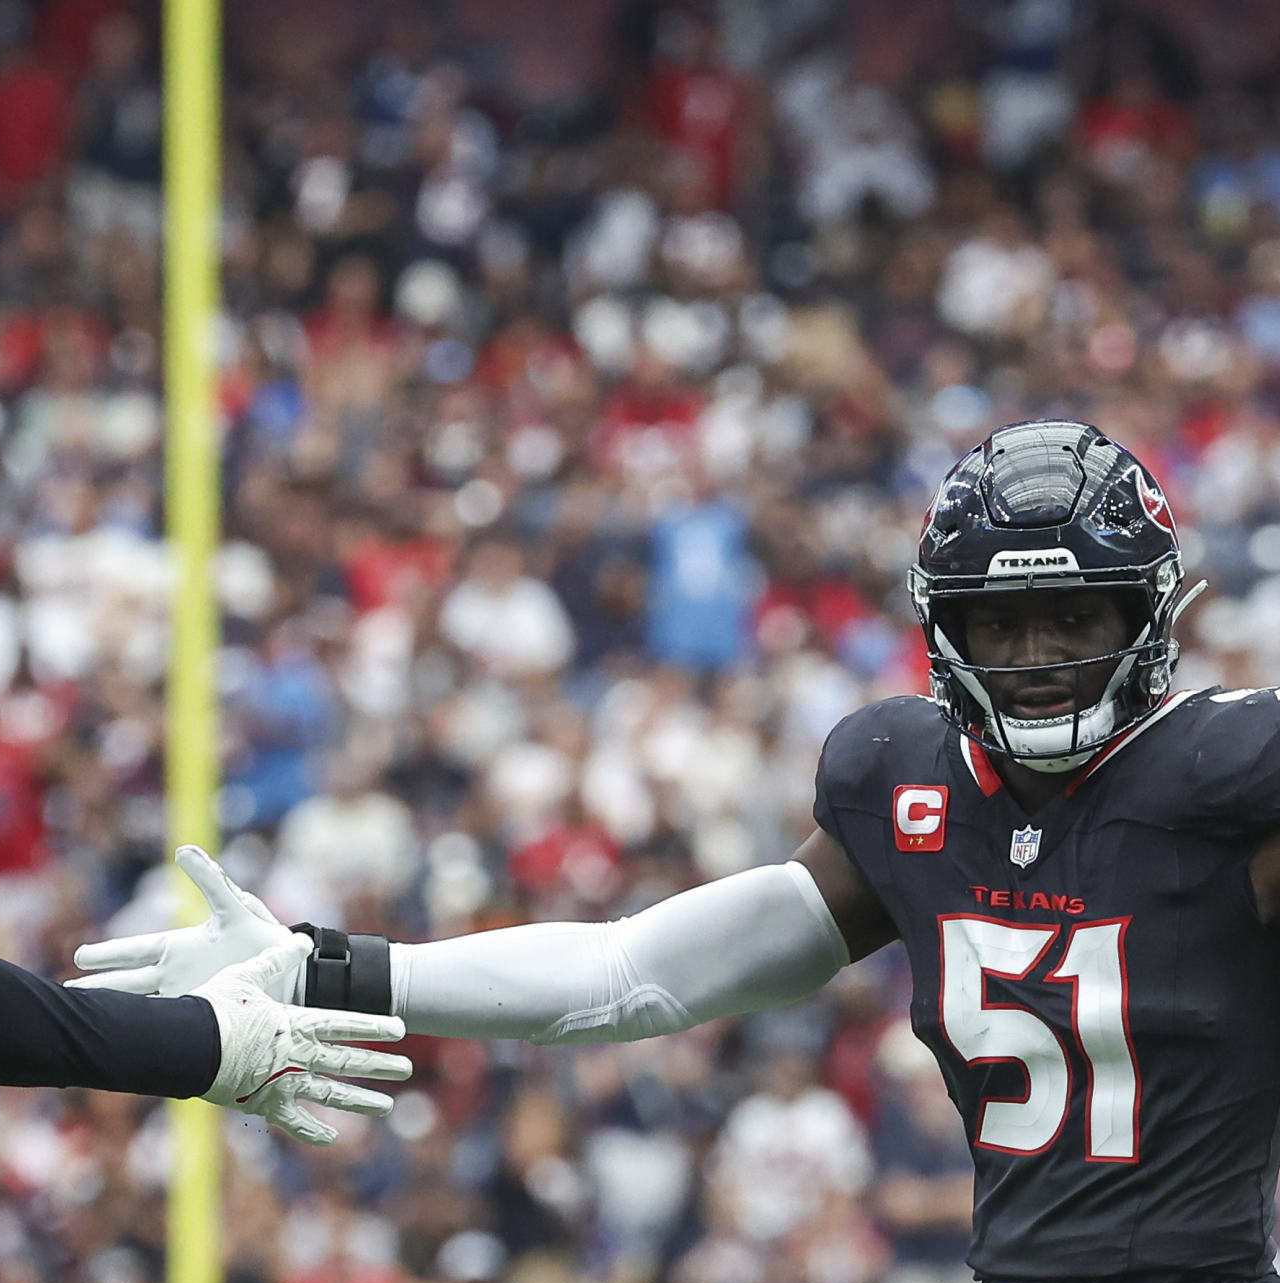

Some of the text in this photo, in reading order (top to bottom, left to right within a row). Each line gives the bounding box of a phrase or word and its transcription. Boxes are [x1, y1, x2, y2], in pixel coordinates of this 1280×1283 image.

[997, 556, 1069, 568] TEXANS
[896, 788, 943, 835] C
[1015, 843, 1035, 861] NFL
[969, 885, 1086, 915] TEXANS
[937, 912, 1141, 1164] 51
